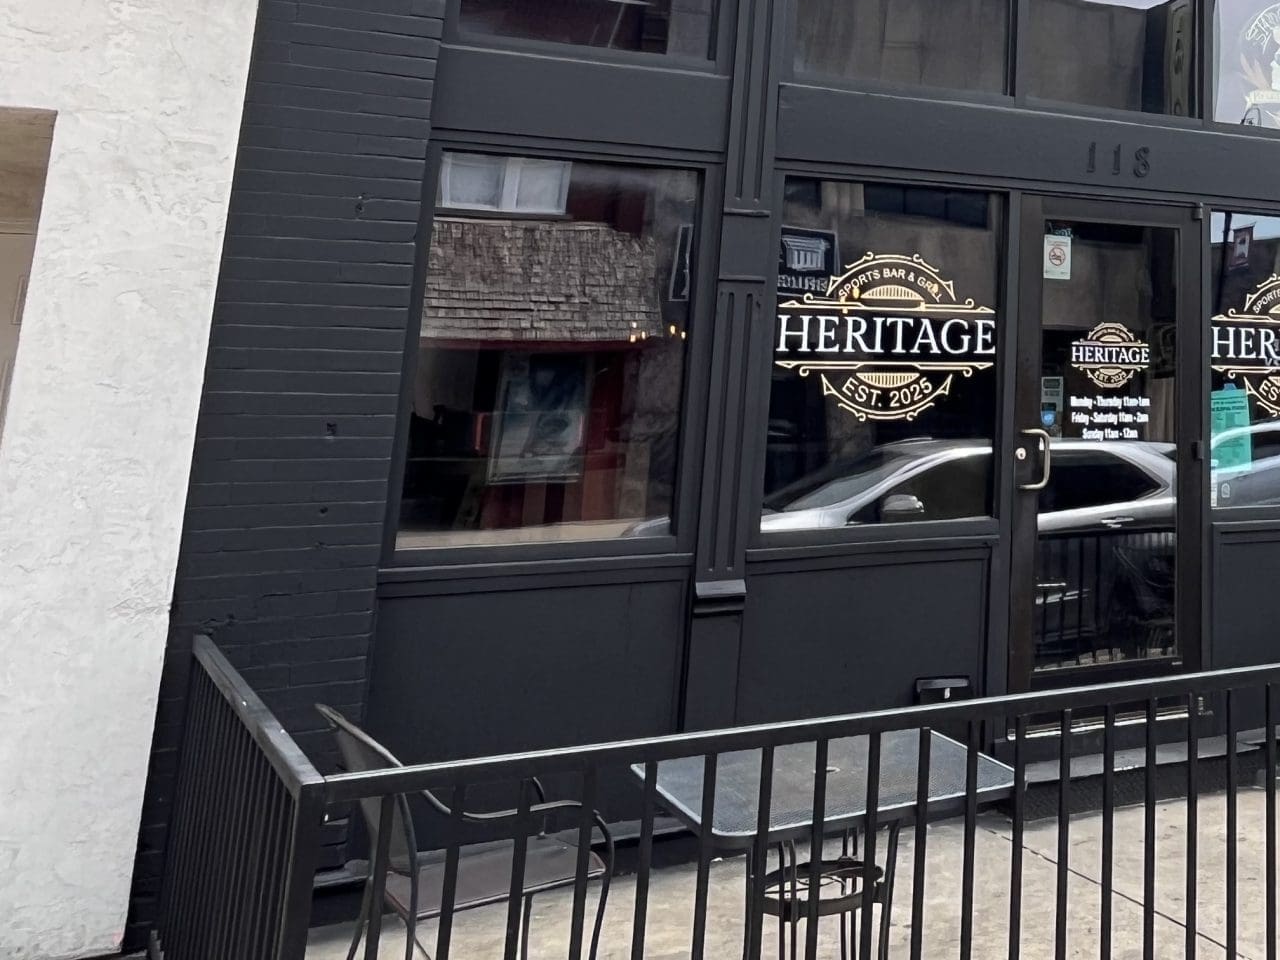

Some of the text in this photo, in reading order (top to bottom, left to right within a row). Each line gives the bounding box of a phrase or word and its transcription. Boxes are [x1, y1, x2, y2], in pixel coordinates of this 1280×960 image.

[838, 269, 881, 299] SPORTS
[883, 268, 906, 279] BAR
[907, 272, 915, 282] &
[775, 314, 997, 355] HERITAGE
[1071, 346, 1150, 363] HERITAGE
[842, 376, 933, 408] EST. 2025
[1071, 411, 1090, 425] Friday
[1093, 411, 1118, 426] Saturday
[1082, 427, 1104, 441] Sunday
